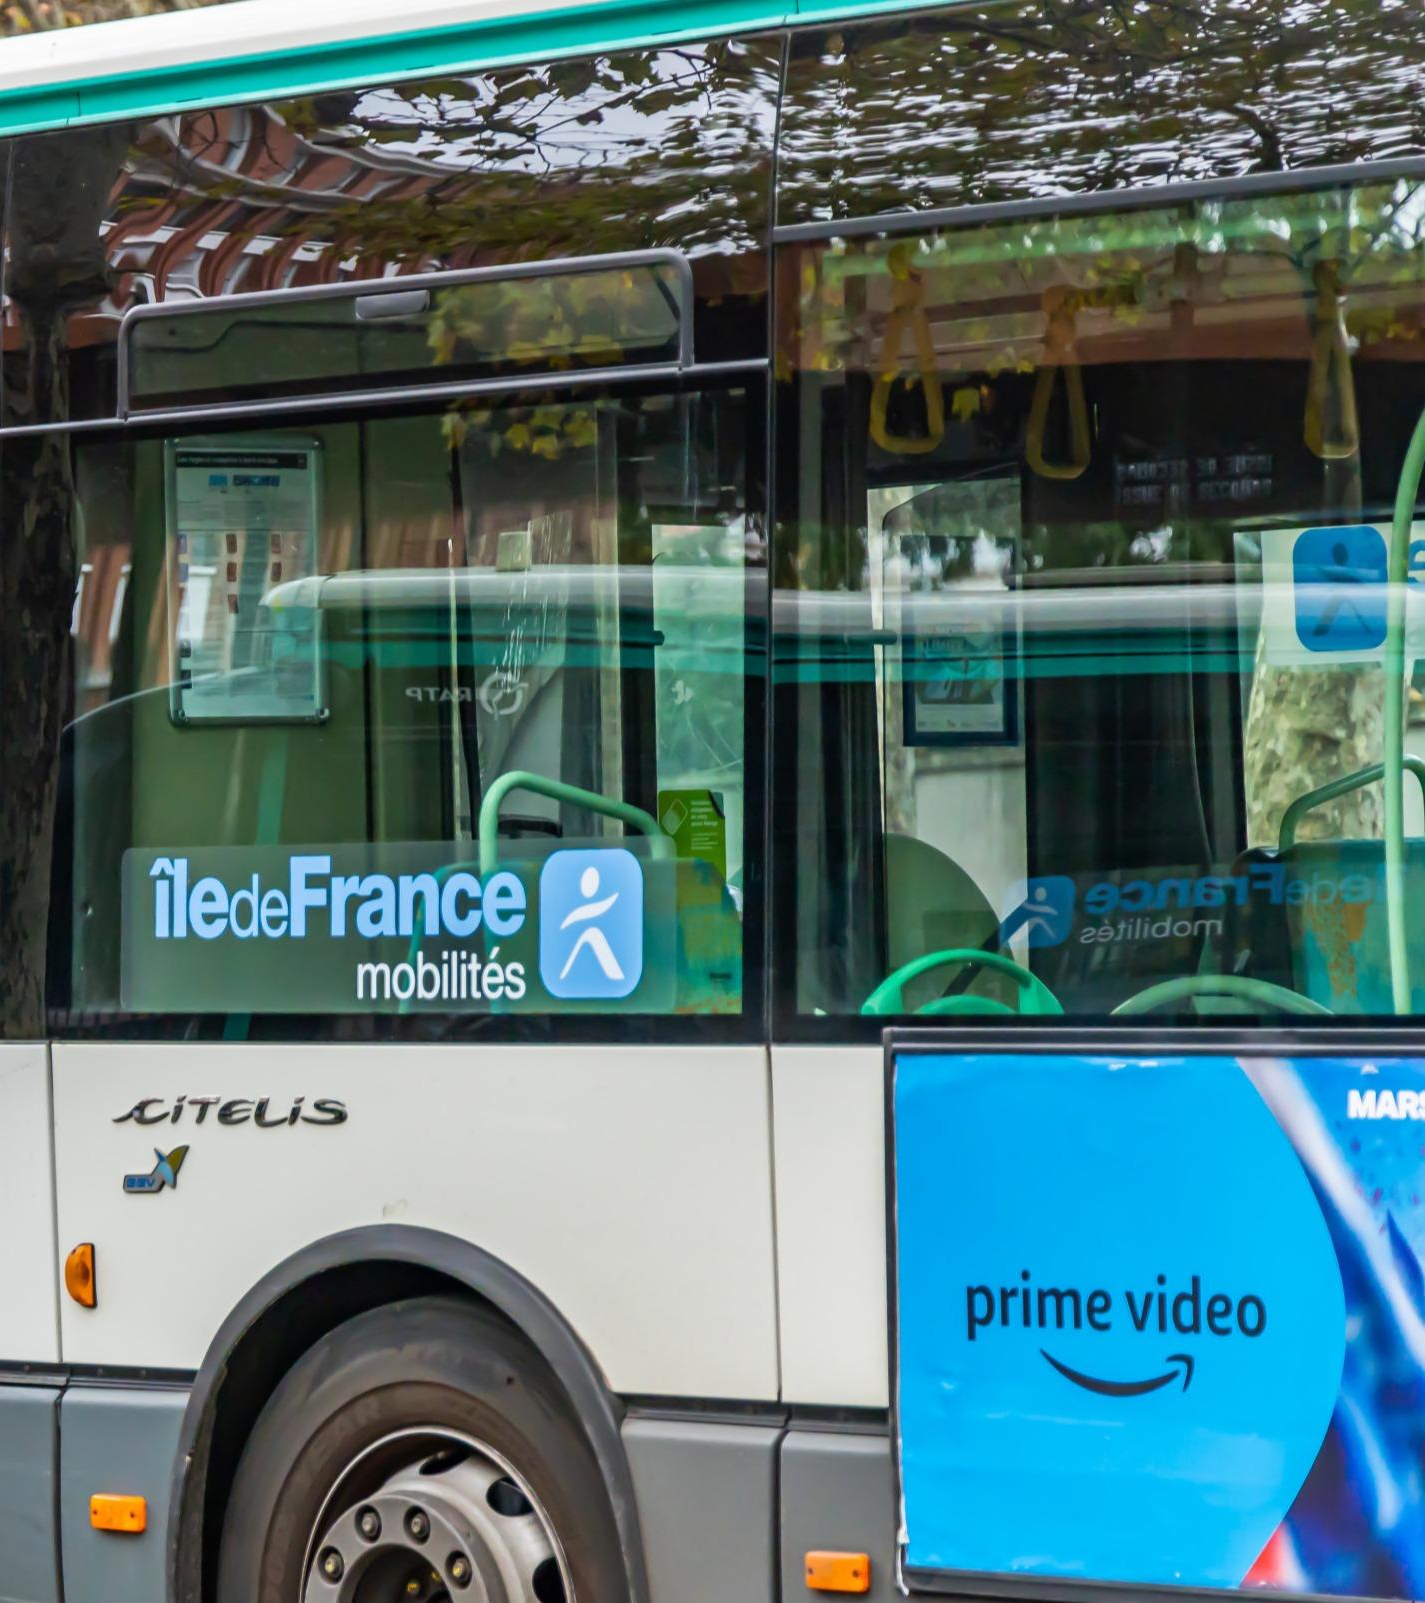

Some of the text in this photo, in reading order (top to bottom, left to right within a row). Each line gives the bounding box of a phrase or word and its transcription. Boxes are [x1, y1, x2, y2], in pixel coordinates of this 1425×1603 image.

[356, 946, 527, 1000] mobilités
[966, 1269, 1267, 1341] prime video
